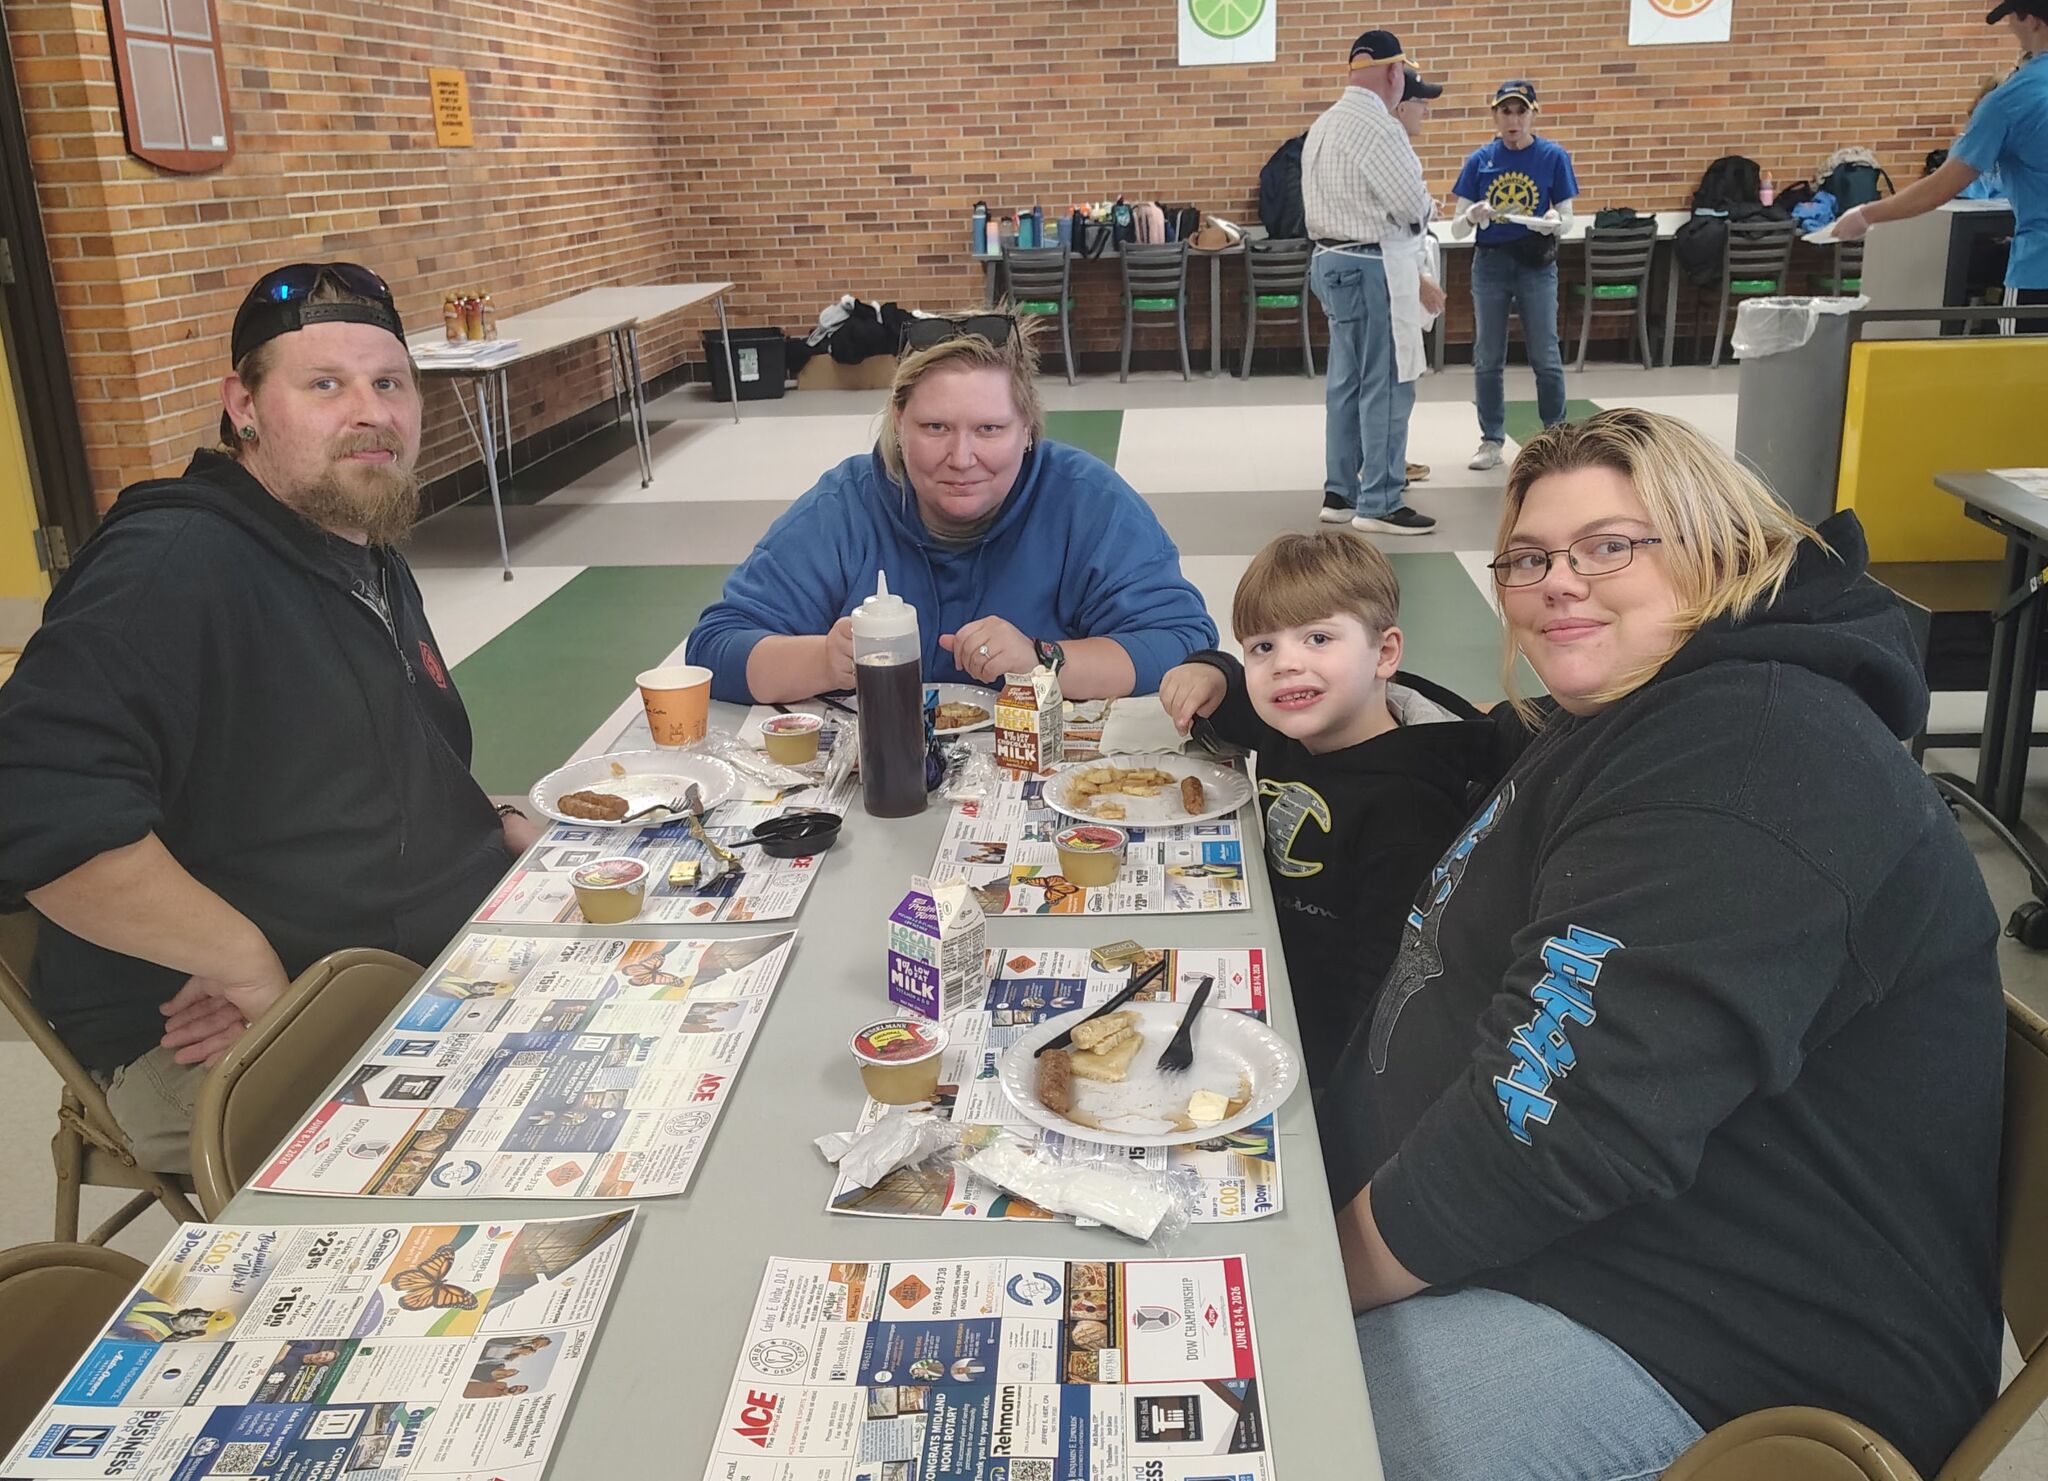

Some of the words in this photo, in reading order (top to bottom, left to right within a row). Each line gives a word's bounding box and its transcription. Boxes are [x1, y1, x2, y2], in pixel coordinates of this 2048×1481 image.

[996, 708, 1033, 721] LOCAL
[997, 719, 1034, 731] FRESH
[998, 739, 1036, 749] CHOCOLATE
[998, 746, 1037, 762] MILK
[892, 923, 934, 949] LOCAL
[891, 938, 936, 966] FRESH
[896, 958, 913, 976] 1%
[914, 965, 930, 977] LOW
[914, 973, 929, 983] FAT
[892, 969, 935, 1001] MILK
[436, 1033, 470, 1068] BUSINESS
[512, 1068, 548, 1107] Rehmann
[692, 1073, 727, 1103] ACE
[308, 1119, 325, 1135] JUNE
[280, 1147, 298, 1166] 2026
[250, 1230, 278, 1279] Benjamins
[324, 1247, 341, 1267] Filter
[364, 1228, 399, 1271] GARBER
[472, 1243, 499, 1283] BUTTERFLIES
[955, 1264, 963, 1279] HOME
[962, 1270, 971, 1285] SALES
[932, 1267, 947, 1315] 989-948-3738
[950, 1286, 961, 1317] SPECIALIZING
[962, 1286, 970, 1299] LAND
[1230, 1286, 1242, 1305] 2026
[287, 1294, 311, 1326] Service
[302, 1301, 317, 1318] Any
[823, 1292, 837, 1315] Maple
[1182, 1278, 1197, 1338] CHAMPIONSHIP
[760, 1314, 777, 1333] Carlos
[1233, 1306, 1245, 1326] 8-14,
[1186, 1340, 1199, 1361] DOW
[1236, 1328, 1248, 1350] JUNE
[134, 1348, 153, 1366] GREAT
[252, 1355, 264, 1369] YEO
[752, 1343, 766, 1368] URIBE
[1104, 1350, 1116, 1380] EASTMAN
[110, 1366, 140, 1400] INSURANCE
[238, 1378, 251, 1390] YEO
[288, 1407, 305, 1423] Take
[533, 1393, 557, 1436] Supporting
[732, 1390, 778, 1448] ACE
[932, 1393, 947, 1433] MIDLAND
[982, 1394, 991, 1420] service.
[1140, 1400, 1149, 1415] Bank
[121, 1410, 144, 1432] FOR
[142, 1410, 175, 1447] Liberty
[282, 1423, 293, 1435] the
[513, 1396, 543, 1449] Strengthening
[766, 1437, 775, 1449] The
[777, 1396, 786, 1414] place.
[944, 1406, 958, 1442] ROTARY
[981, 1420, 990, 1436] your
[994, 1386, 1015, 1455] Rehmann
[1070, 1416, 1078, 1443] EDWARDS
[1141, 1416, 1149, 1432] State
[104, 1411, 162, 1476] BUSINESS
[395, 1409, 425, 1458] GREATER
[103, 1435, 122, 1457] ALL
[266, 1436, 285, 1461] survey!
[925, 1435, 941, 1481] ONGRATS
[941, 1443, 954, 1472] NOON
[978, 1446, 987, 1461] you
[126, 1450, 146, 1471] and
[321, 1446, 346, 1481] CONGR
[975, 1460, 985, 1481] Thank
[1068, 1448, 1077, 1478] BENJAMIN
